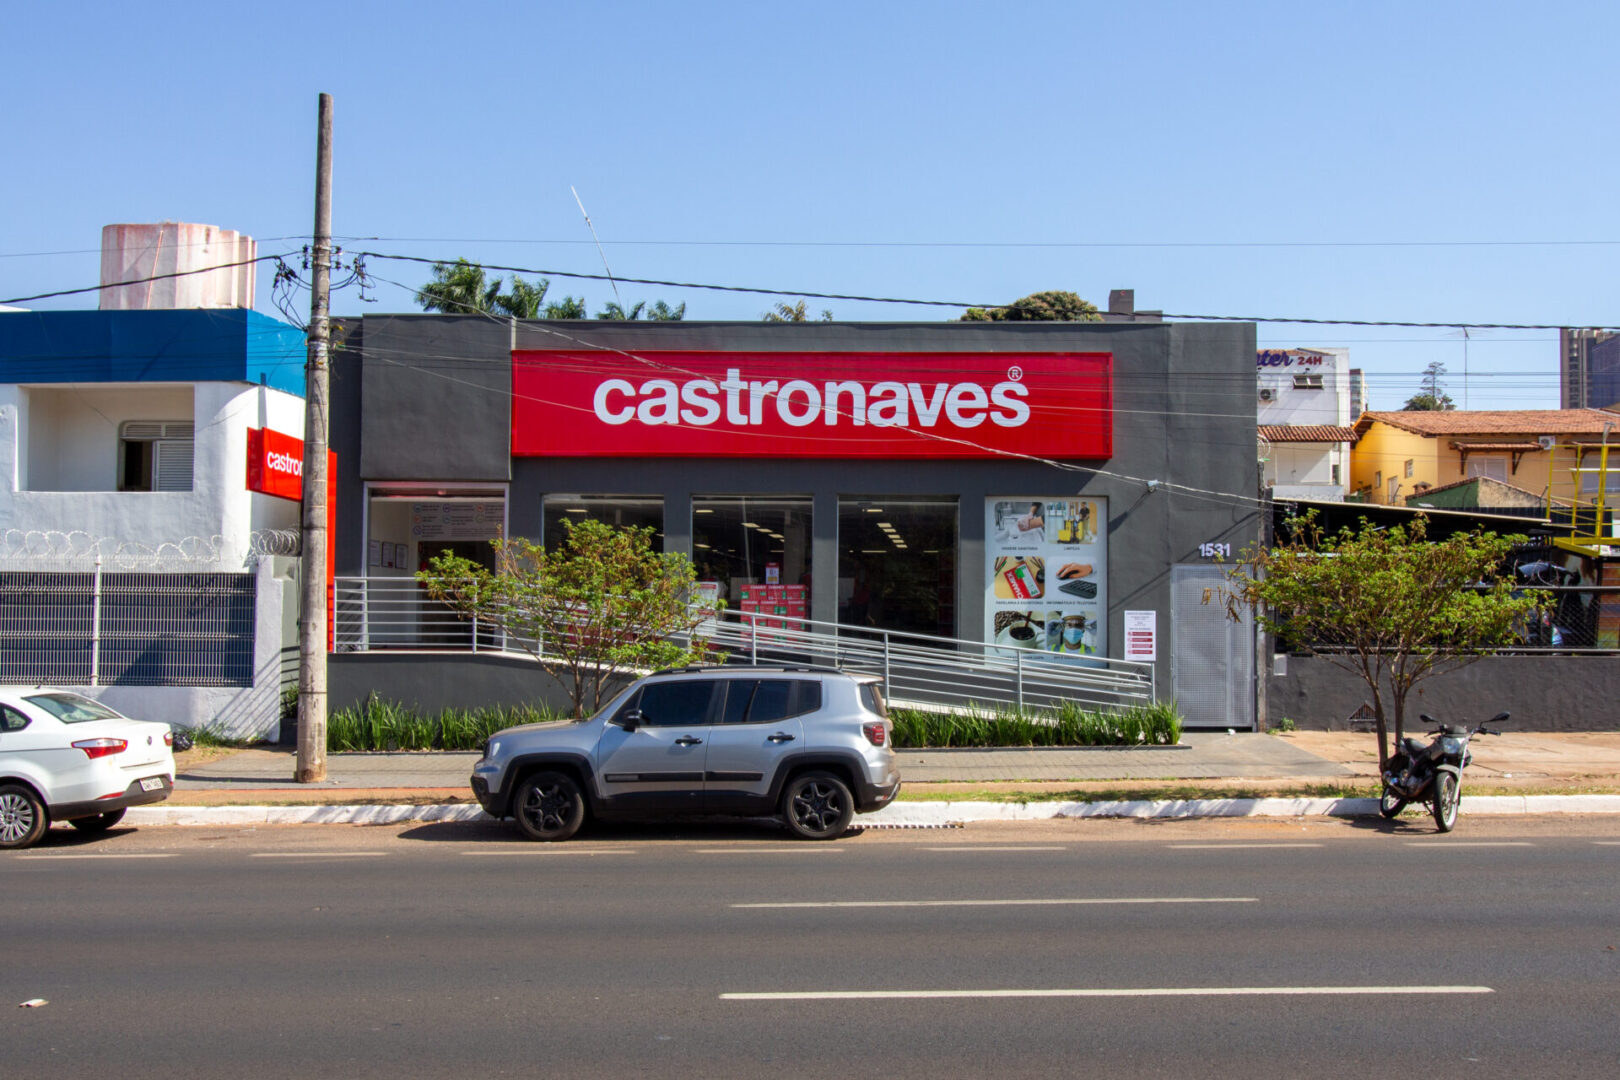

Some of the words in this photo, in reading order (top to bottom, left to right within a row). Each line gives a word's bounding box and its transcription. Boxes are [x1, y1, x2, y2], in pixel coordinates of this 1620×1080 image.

[1298, 356, 1323, 366] 24H
[593, 368, 1031, 428] castronaves
[1199, 543, 1231, 557] 1531
